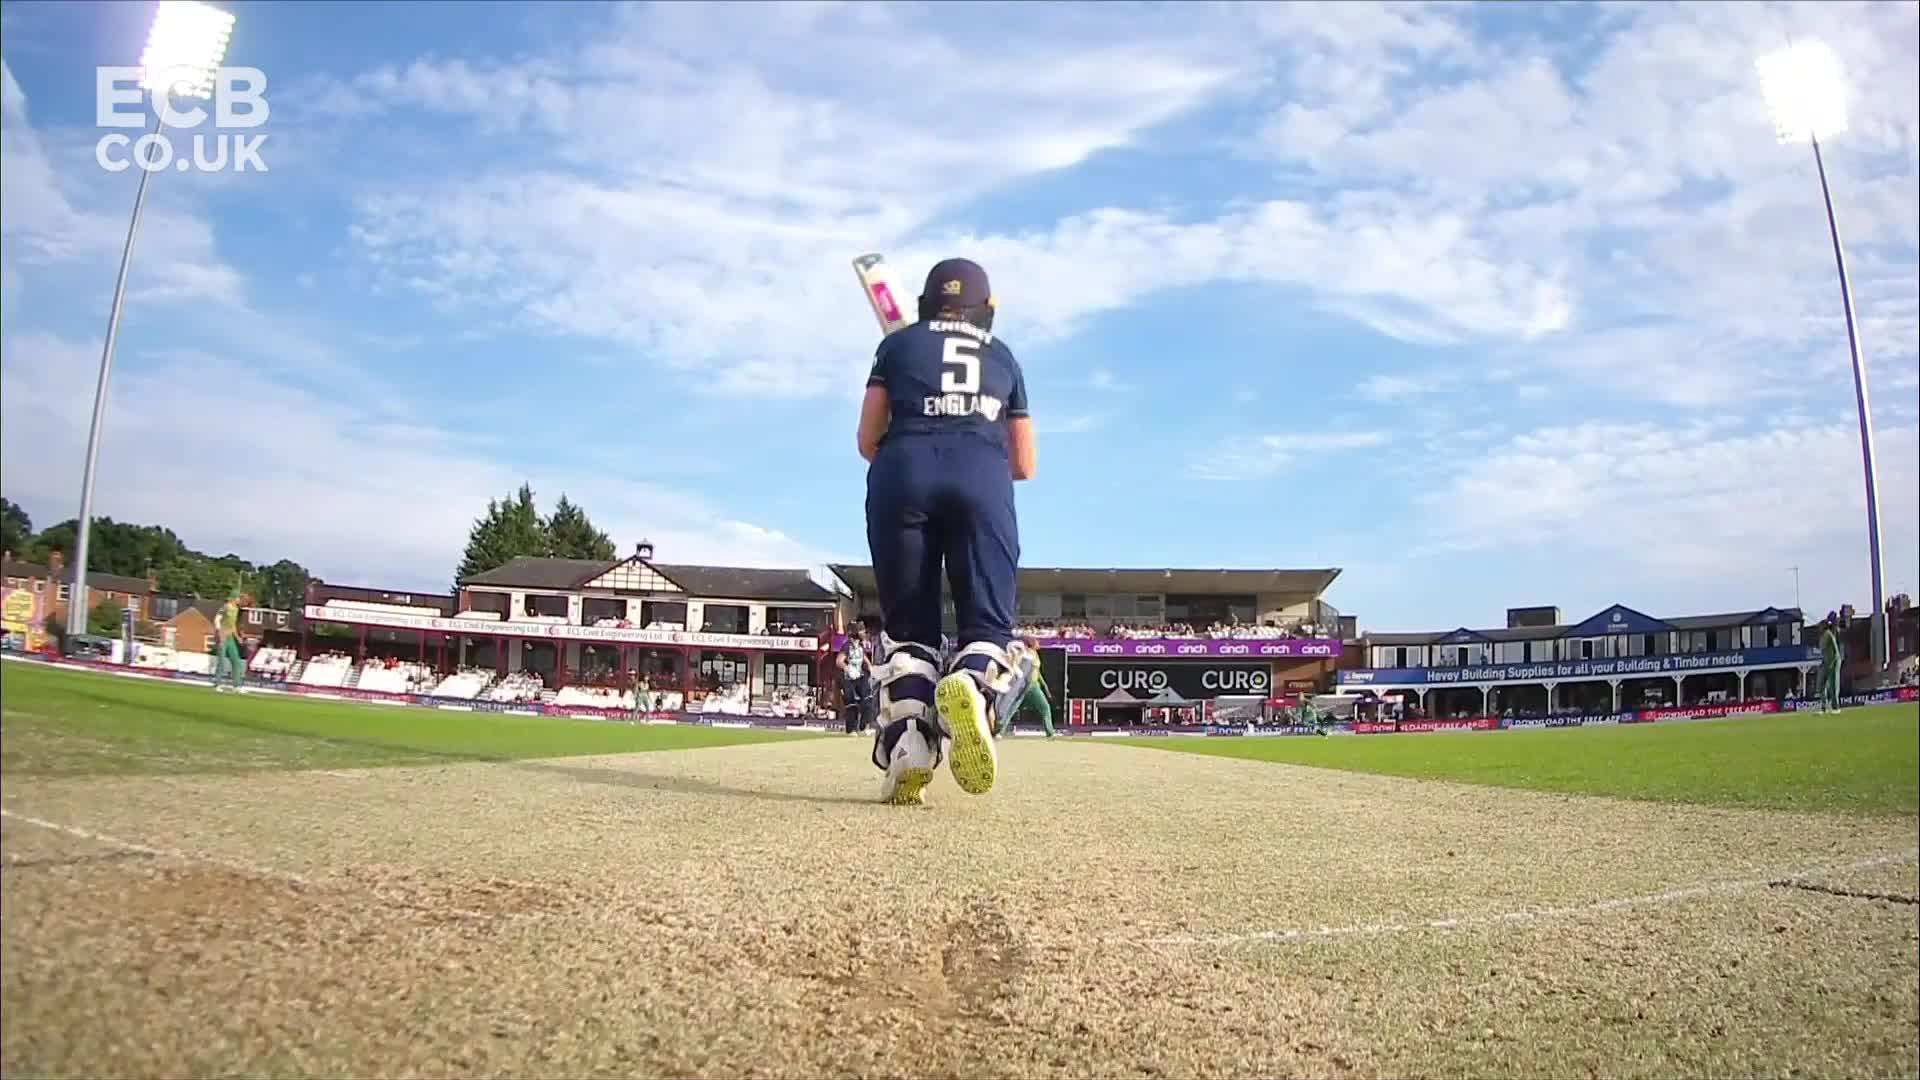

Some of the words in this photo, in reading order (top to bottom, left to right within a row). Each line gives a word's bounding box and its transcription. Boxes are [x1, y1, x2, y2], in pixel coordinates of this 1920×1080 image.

[941, 337, 980, 393] 5
[923, 393, 1002, 422] ENGLAND
[1093, 641, 1123, 653] cinch
[1135, 641, 1165, 653] cinch
[1177, 641, 1207, 653] cinch
[1219, 641, 1249, 653] cinch
[1260, 641, 1290, 654] cinch
[1301, 641, 1330, 654] cinch
[1427, 670, 1460, 681] Hevey
[1462, 667, 1505, 680] Building
[1507, 666, 1554, 678] Supplies
[1557, 664, 1572, 675] for
[1575, 664, 1589, 675] all
[1591, 663, 1614, 676] your
[1617, 660, 1661, 672] Building
[1663, 659, 1671, 669] &
[1673, 657, 1709, 669] Timber
[1712, 653, 1744, 665] needs
[1100, 670, 1168, 689] CURO
[1201, 670, 1268, 689] CURO
